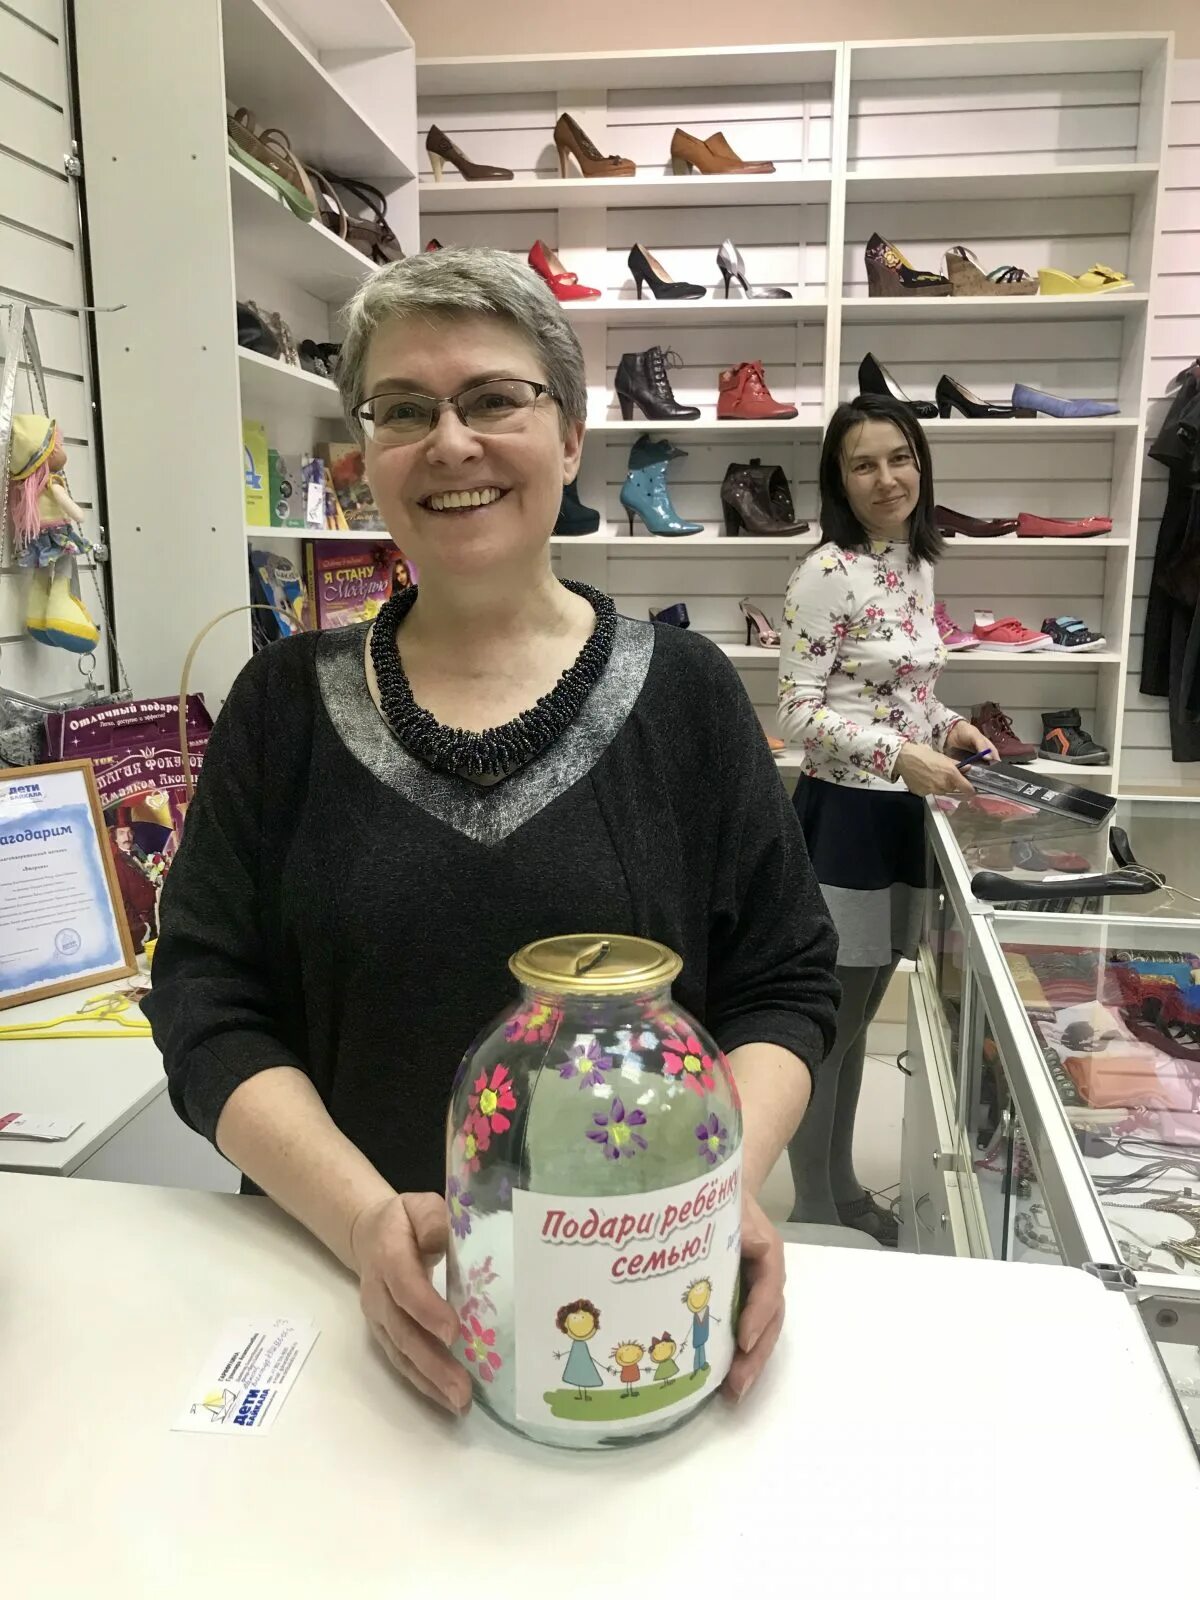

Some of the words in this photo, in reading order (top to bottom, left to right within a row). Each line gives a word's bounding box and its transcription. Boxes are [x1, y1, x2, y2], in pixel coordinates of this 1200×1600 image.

[324, 572, 333, 584] Я
[336, 566, 375, 582] СТАНУ
[70, 704, 137, 730] Отличный
[140, 701, 189, 713] подаро!
[541, 1208, 655, 1243] Подари
[611, 1223, 712, 1277] семью!
[246, 1388, 270, 1426] БАЙКАЛА
